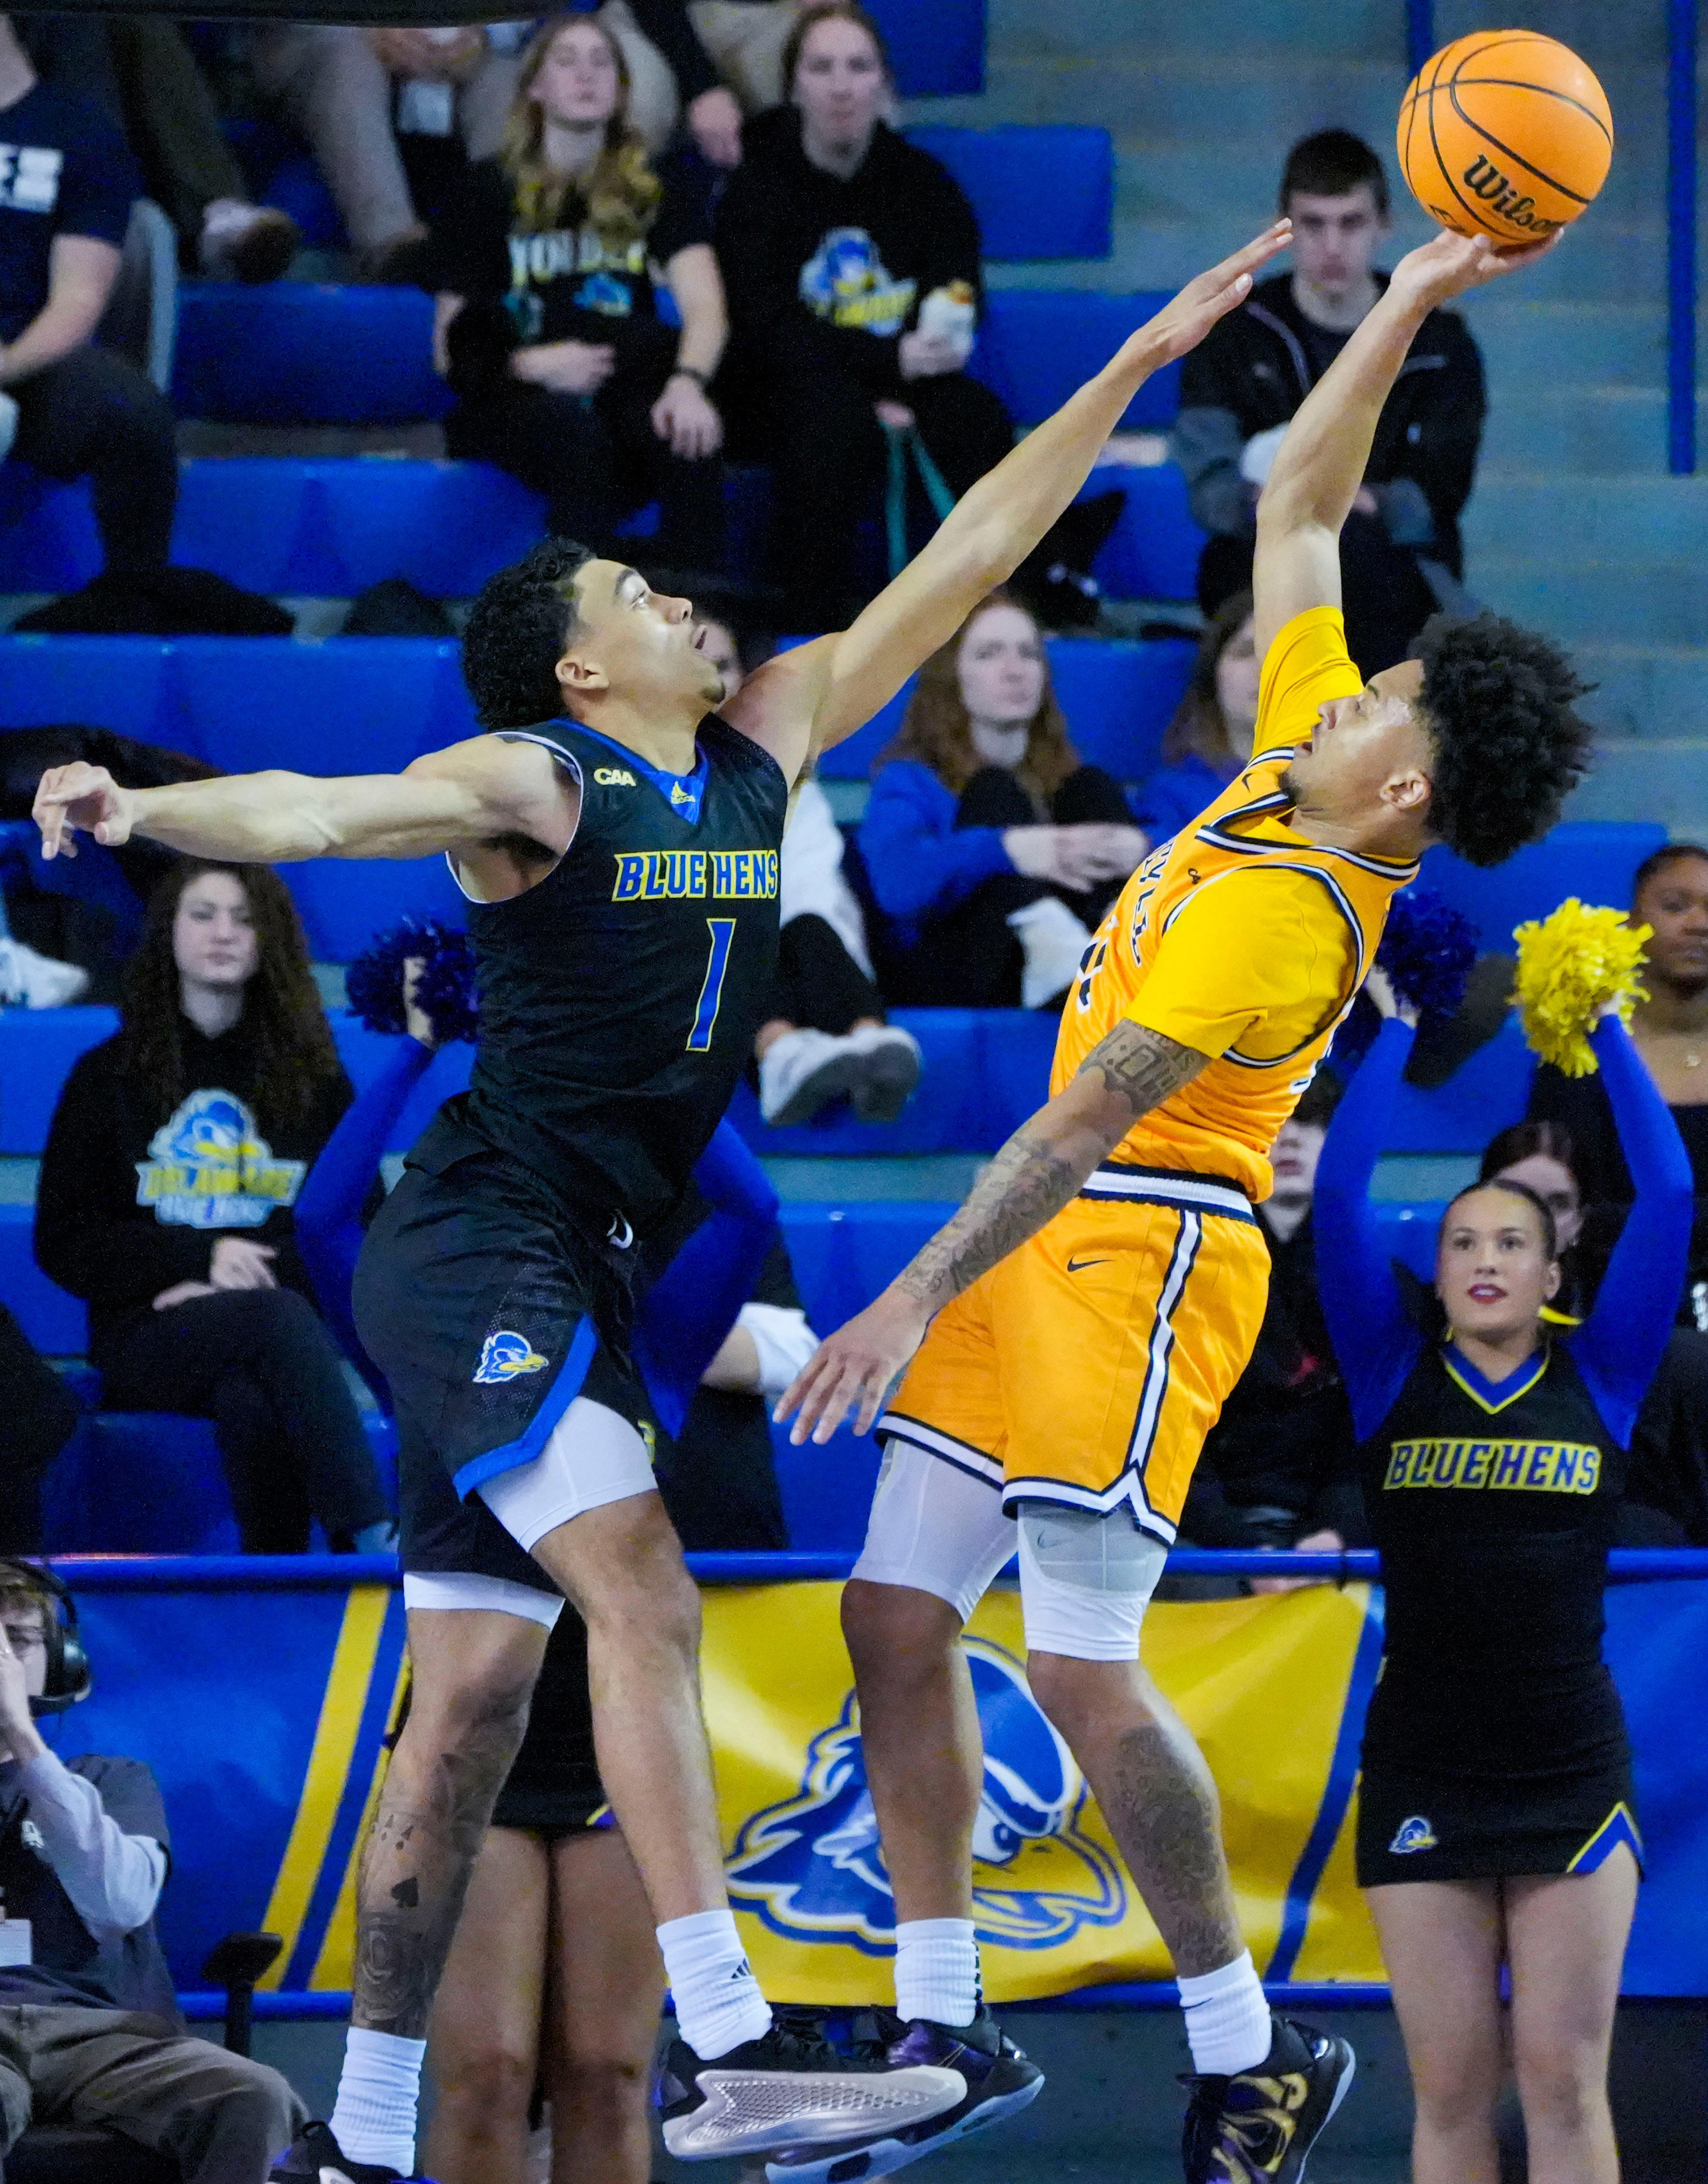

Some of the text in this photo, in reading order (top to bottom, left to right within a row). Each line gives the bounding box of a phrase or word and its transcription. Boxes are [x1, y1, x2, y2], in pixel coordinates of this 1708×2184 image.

[593, 768, 637, 787] CAA
[611, 850, 778, 902] BLUE HENS
[685, 918, 737, 1052] 1
[1382, 1438, 1602, 1495] BLUE HENS
